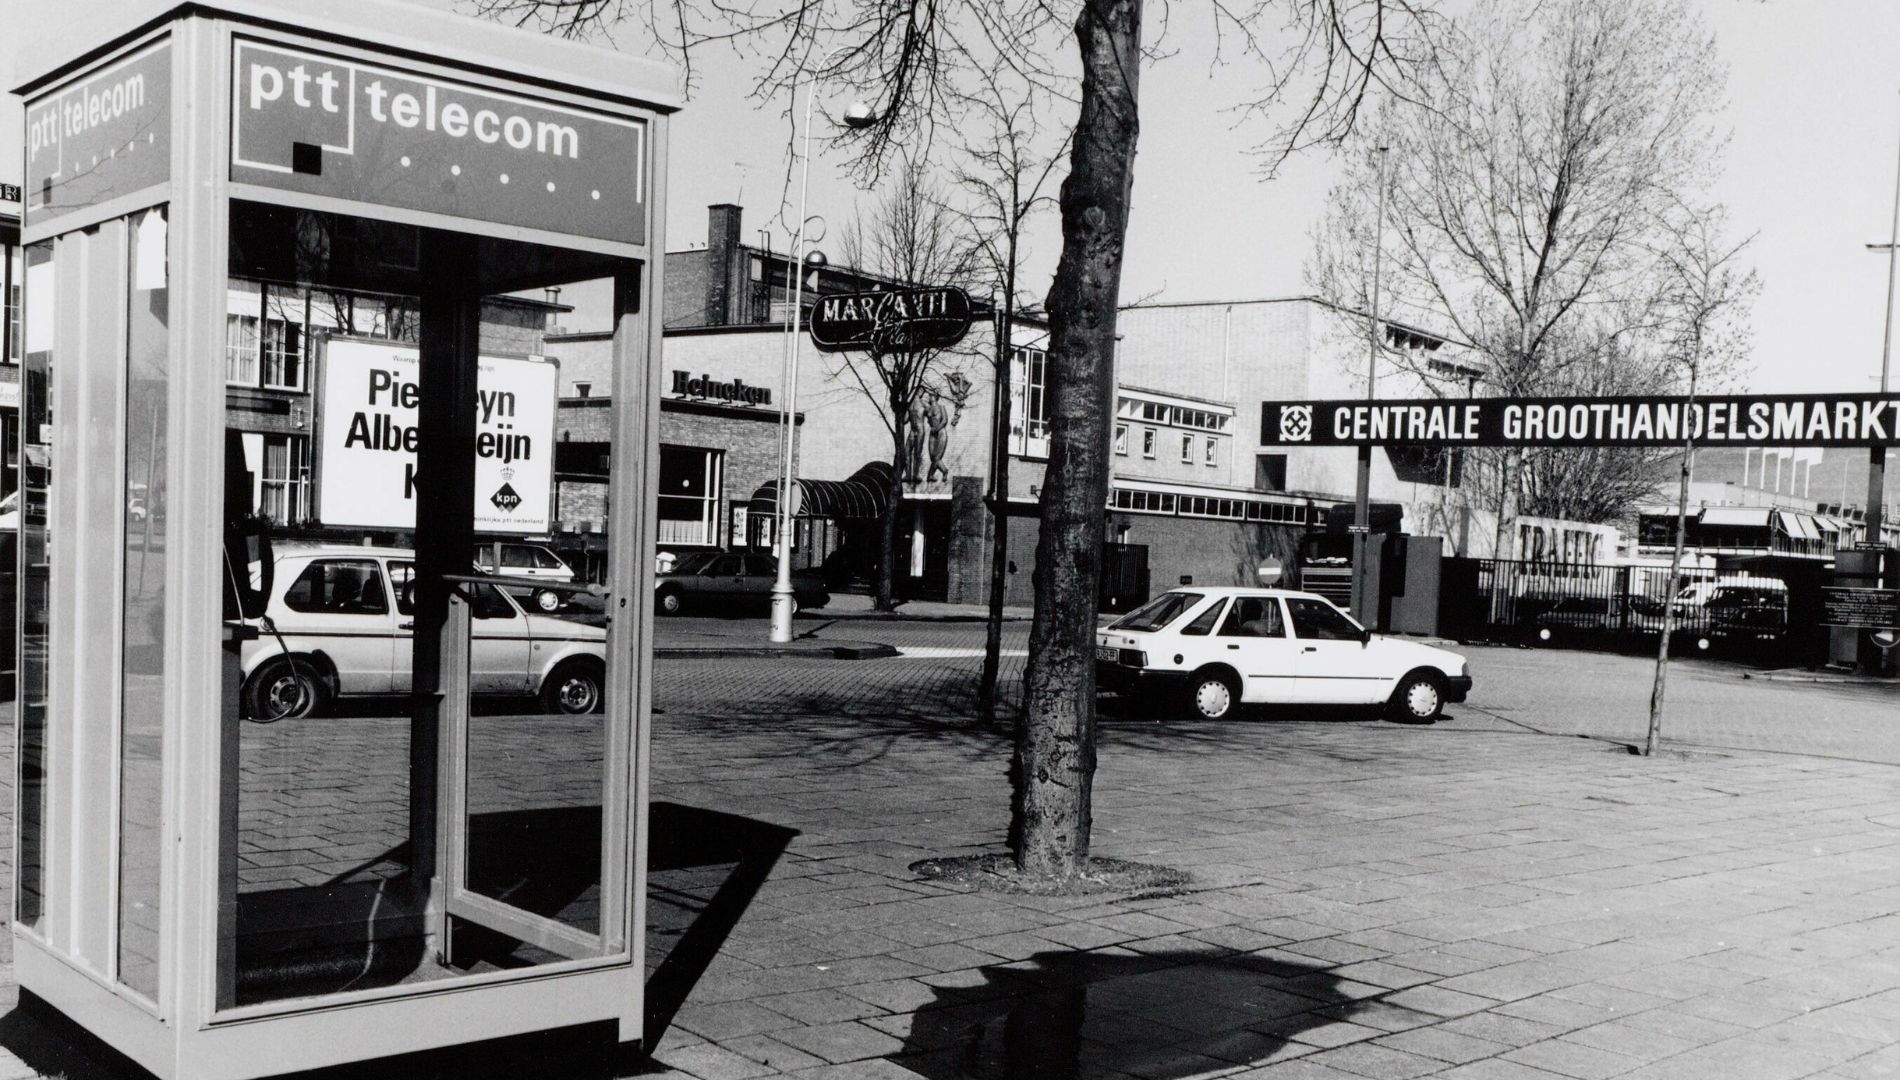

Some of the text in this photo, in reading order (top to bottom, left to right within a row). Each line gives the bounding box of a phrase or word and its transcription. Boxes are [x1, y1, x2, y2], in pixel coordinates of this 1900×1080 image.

[31, 73, 144, 162] ptt telecom
[250, 63, 578, 159] ptt telecom
[368, 368, 515, 424] Pie yn
[671, 370, 772, 405] Heineken
[344, 411, 531, 464] Albe eijn
[1334, 400, 1900, 440] CENTRALE GROOTHANDELSMARKT
[496, 493, 518, 504] kpn
